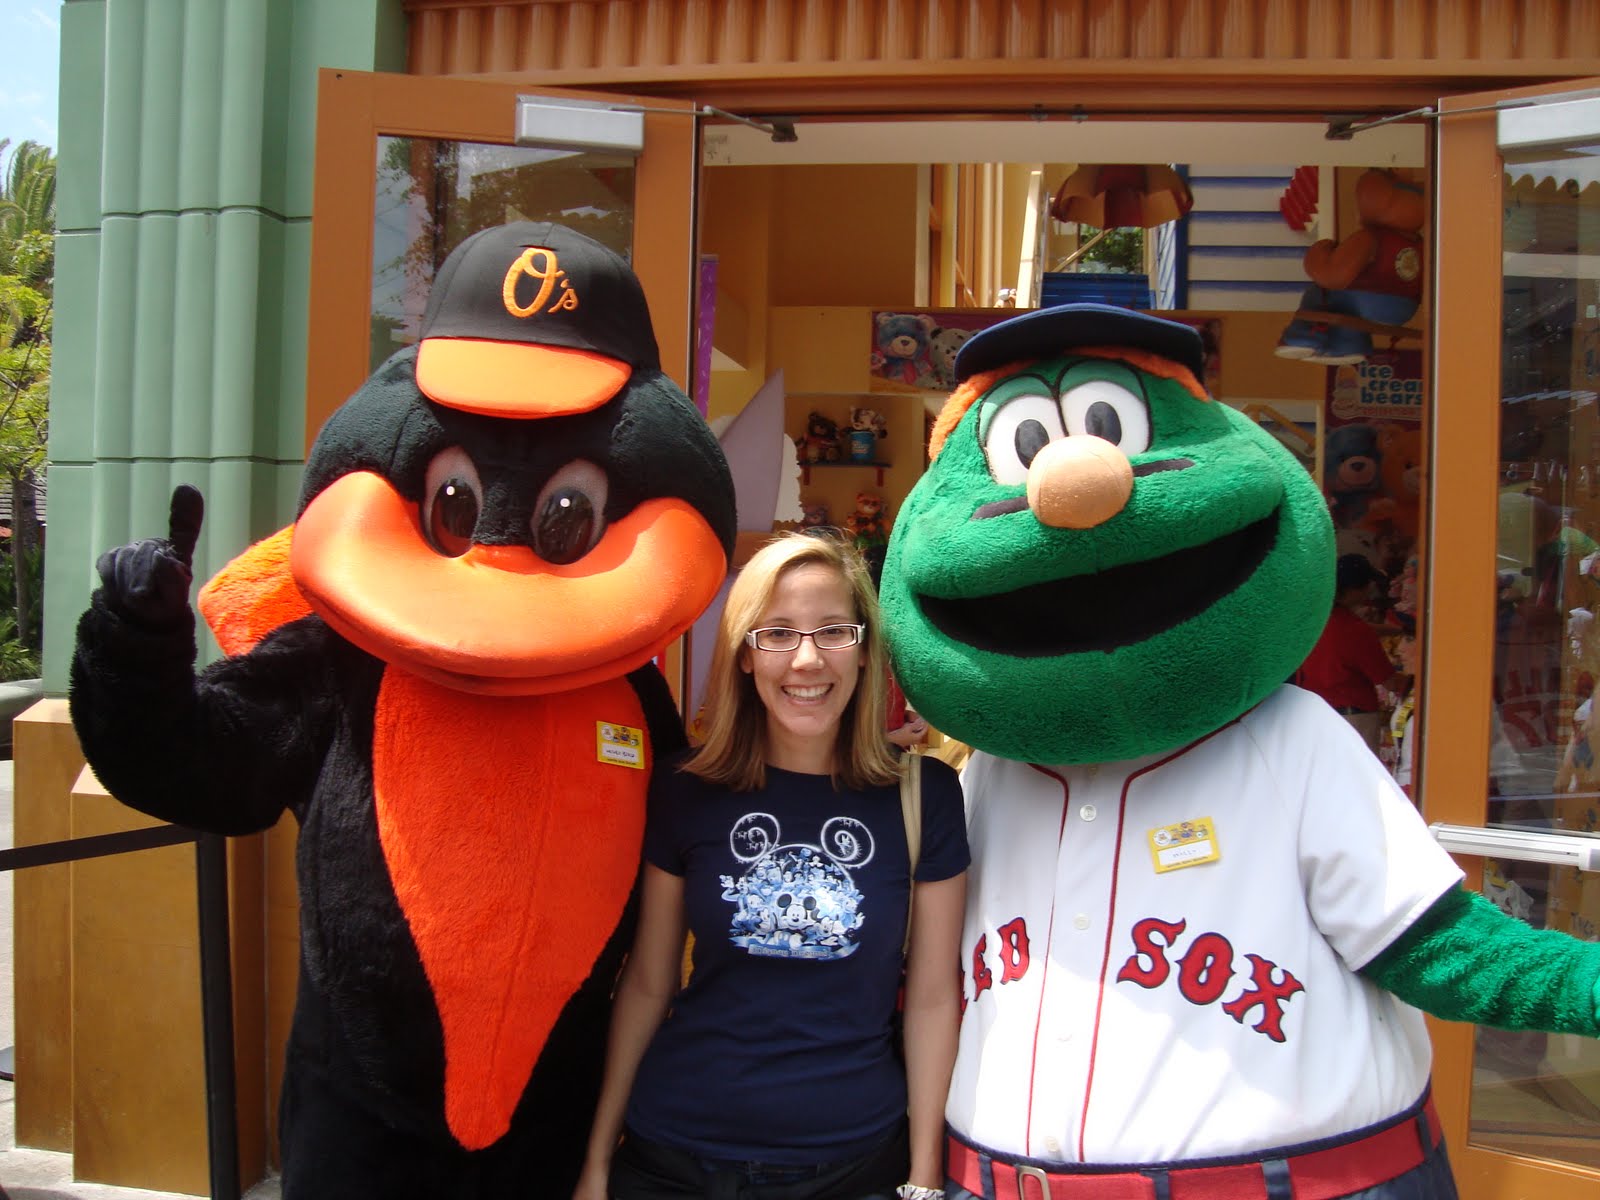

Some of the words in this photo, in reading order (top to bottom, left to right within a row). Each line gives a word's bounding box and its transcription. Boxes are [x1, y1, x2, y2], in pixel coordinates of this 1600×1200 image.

[503, 248, 578, 317] O's
[1360, 361, 1392, 378] ice
[1369, 380, 1424, 392] crea
[1361, 387, 1423, 405] bears
[959, 917, 1030, 1025] ED
[1116, 917, 1305, 1043] SOX
